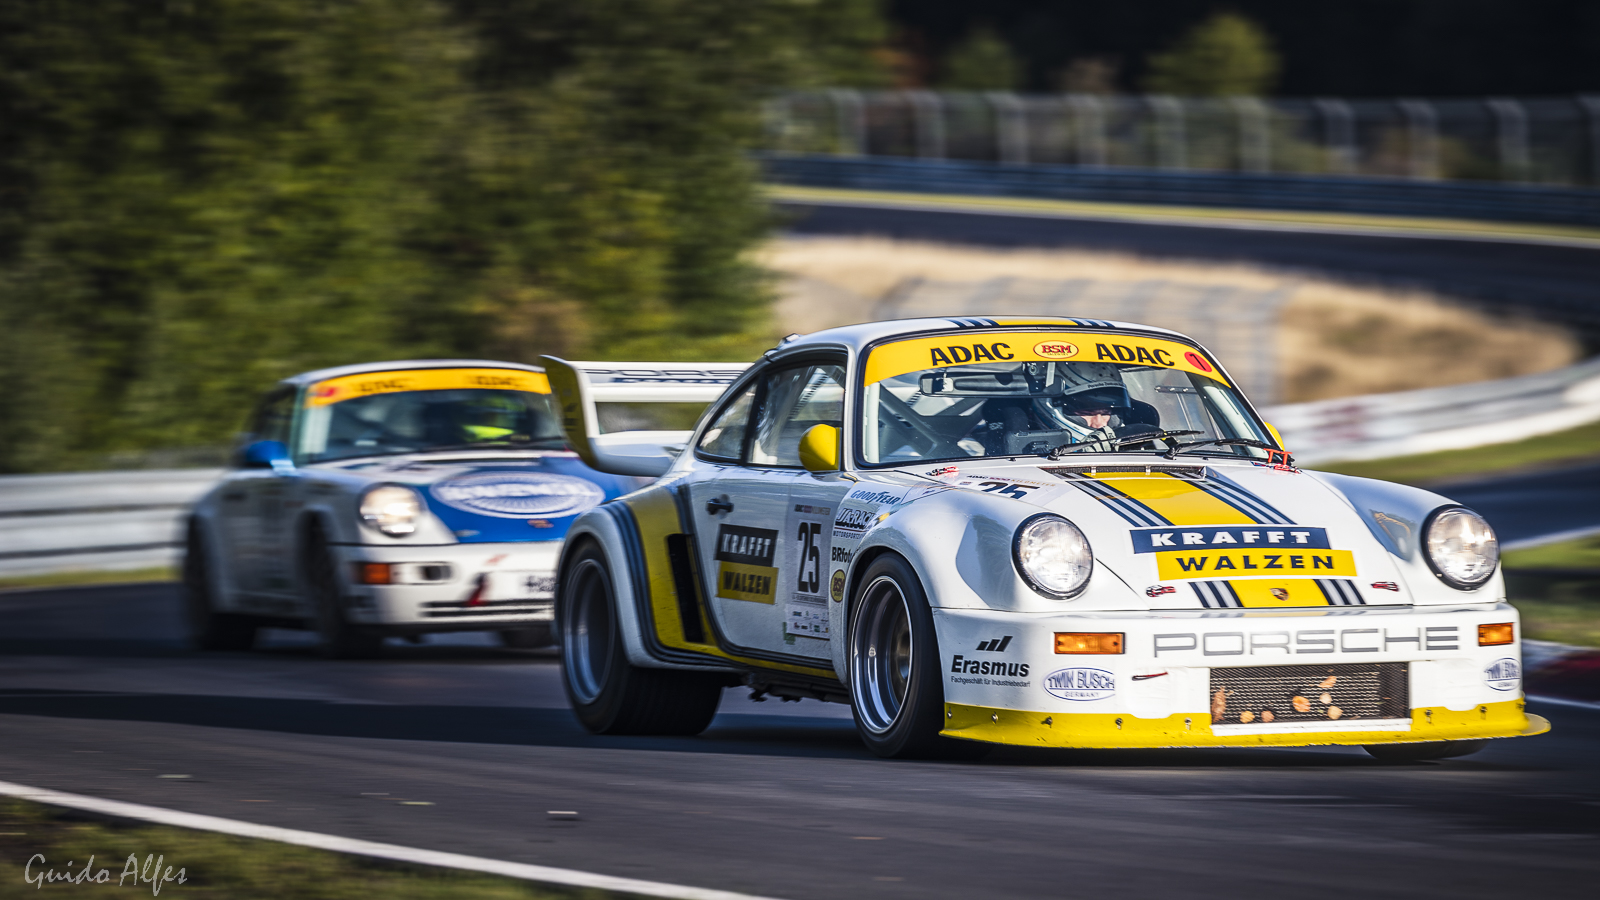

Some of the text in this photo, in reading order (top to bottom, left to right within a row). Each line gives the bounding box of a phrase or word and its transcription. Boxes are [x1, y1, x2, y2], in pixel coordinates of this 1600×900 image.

[930, 342, 1015, 366] ADAC
[1041, 345, 1073, 354] BSM
[1095, 342, 1175, 367] ADAC
[850, 489, 902, 505] GOODYEAR
[978, 481, 1041, 500] 25
[720, 532, 772, 558] KRAFFT
[1150, 530, 1311, 548] KRAFFT
[797, 521, 822, 594] 25
[1175, 554, 1335, 572] WALZEN
[721, 570, 773, 596] WALZEN
[1153, 626, 1459, 658] PORSCHE
[951, 654, 1030, 677] Erasmus
[951, 675, 983, 686] Fachgeschäft
[991, 678, 1031, 688] Industriebedarf
[1047, 670, 1115, 689] TWIN BUSCH
